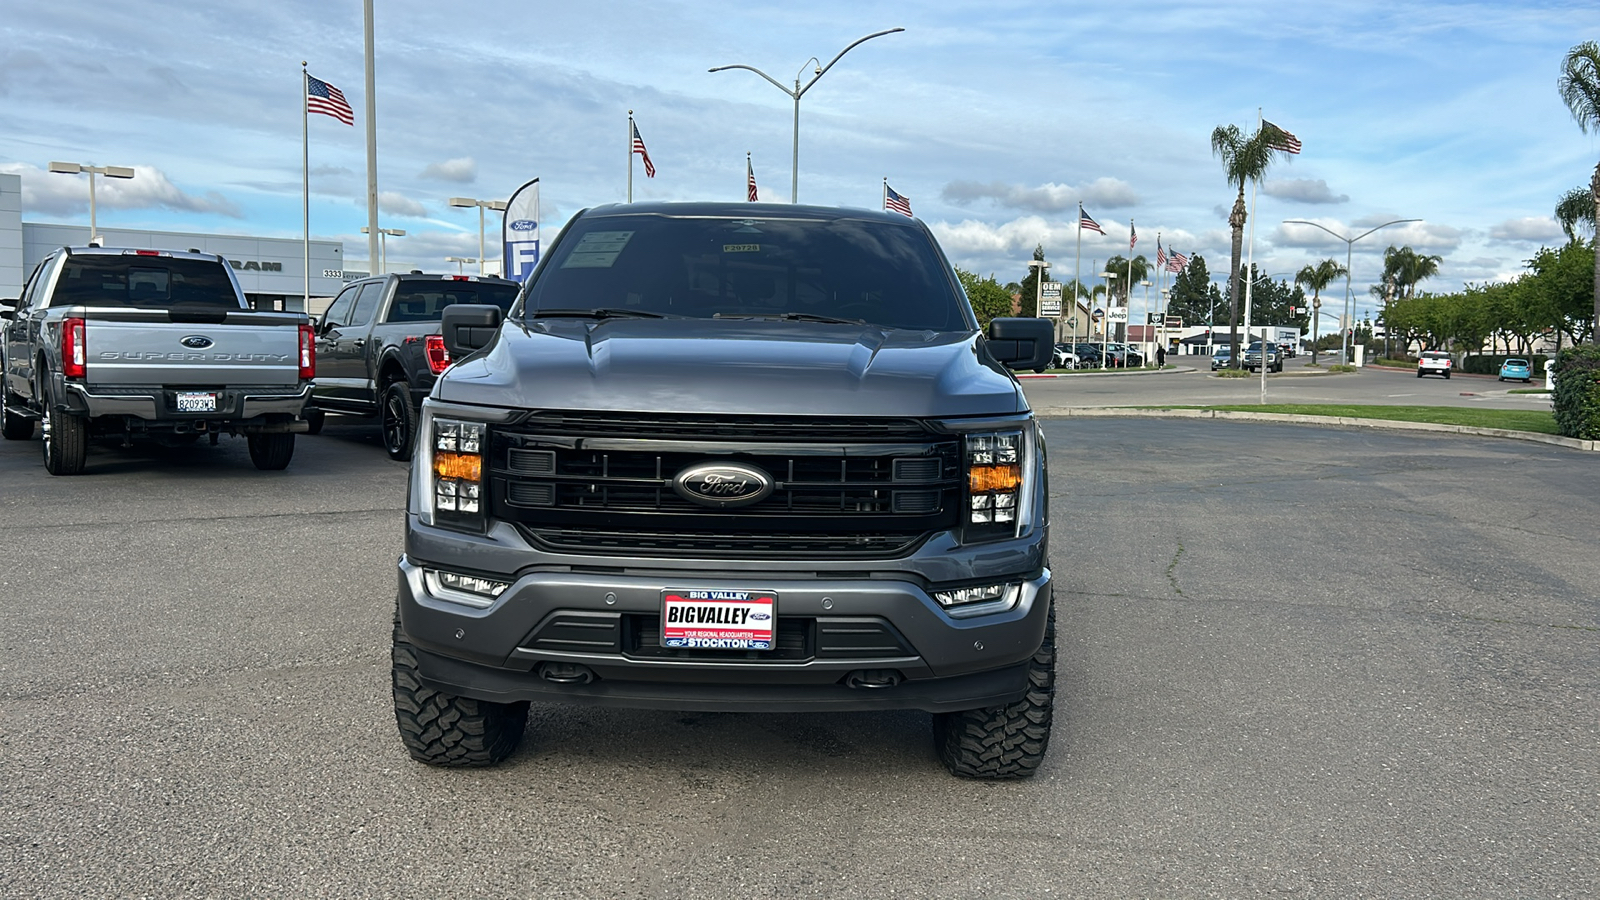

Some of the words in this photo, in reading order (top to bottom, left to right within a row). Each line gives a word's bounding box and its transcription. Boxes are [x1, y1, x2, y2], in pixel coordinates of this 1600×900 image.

[514, 221, 533, 230] Ford
[228, 260, 282, 272] RAM
[324, 270, 342, 278] 3333
[1043, 283, 1061, 291] OEM
[1109, 311, 1127, 320] Jeep
[100, 351, 206, 361] SUPER
[213, 353, 289, 362] DUTY
[179, 399, 215, 409] 82093W3
[699, 473, 747, 495] Ford
[689, 591, 709, 599] BIG
[711, 592, 749, 600] VALLEY
[667, 606, 751, 625] BIGVALLEY
[751, 612, 769, 620] Ford
[719, 631, 754, 639] HEADQUARTERS
[688, 638, 748, 648] STOCKTON
